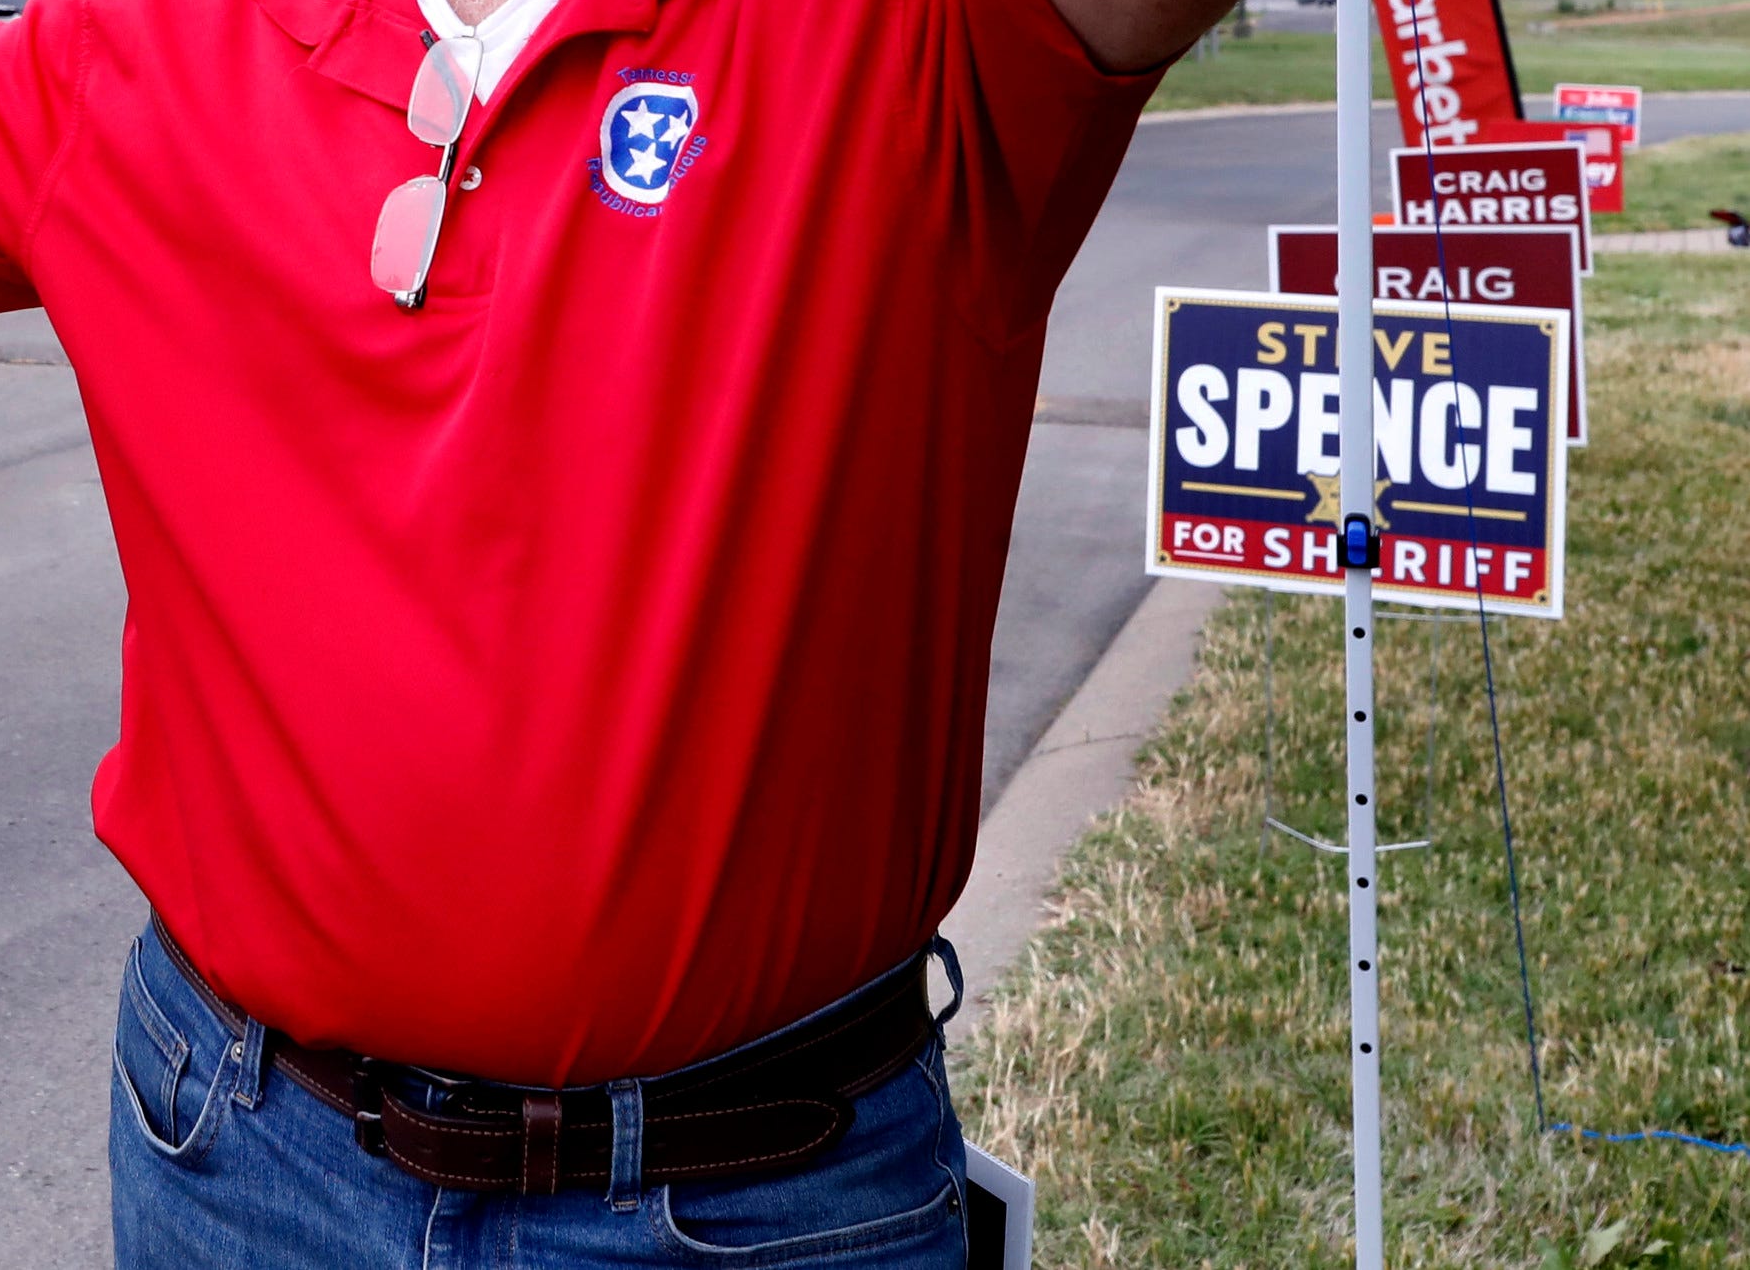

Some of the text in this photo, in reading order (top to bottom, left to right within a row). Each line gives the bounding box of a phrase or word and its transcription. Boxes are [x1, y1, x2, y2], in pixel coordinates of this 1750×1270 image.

[1434, 168, 1548, 194] CRAIG
[1405, 194, 1580, 225] HARRIS
[1334, 266, 1516, 300] RAIG
[1256, 321, 1454, 376] STVE
[1175, 363, 1539, 495] SPENCE
[1173, 521, 1533, 592] FOR SHRIFF
